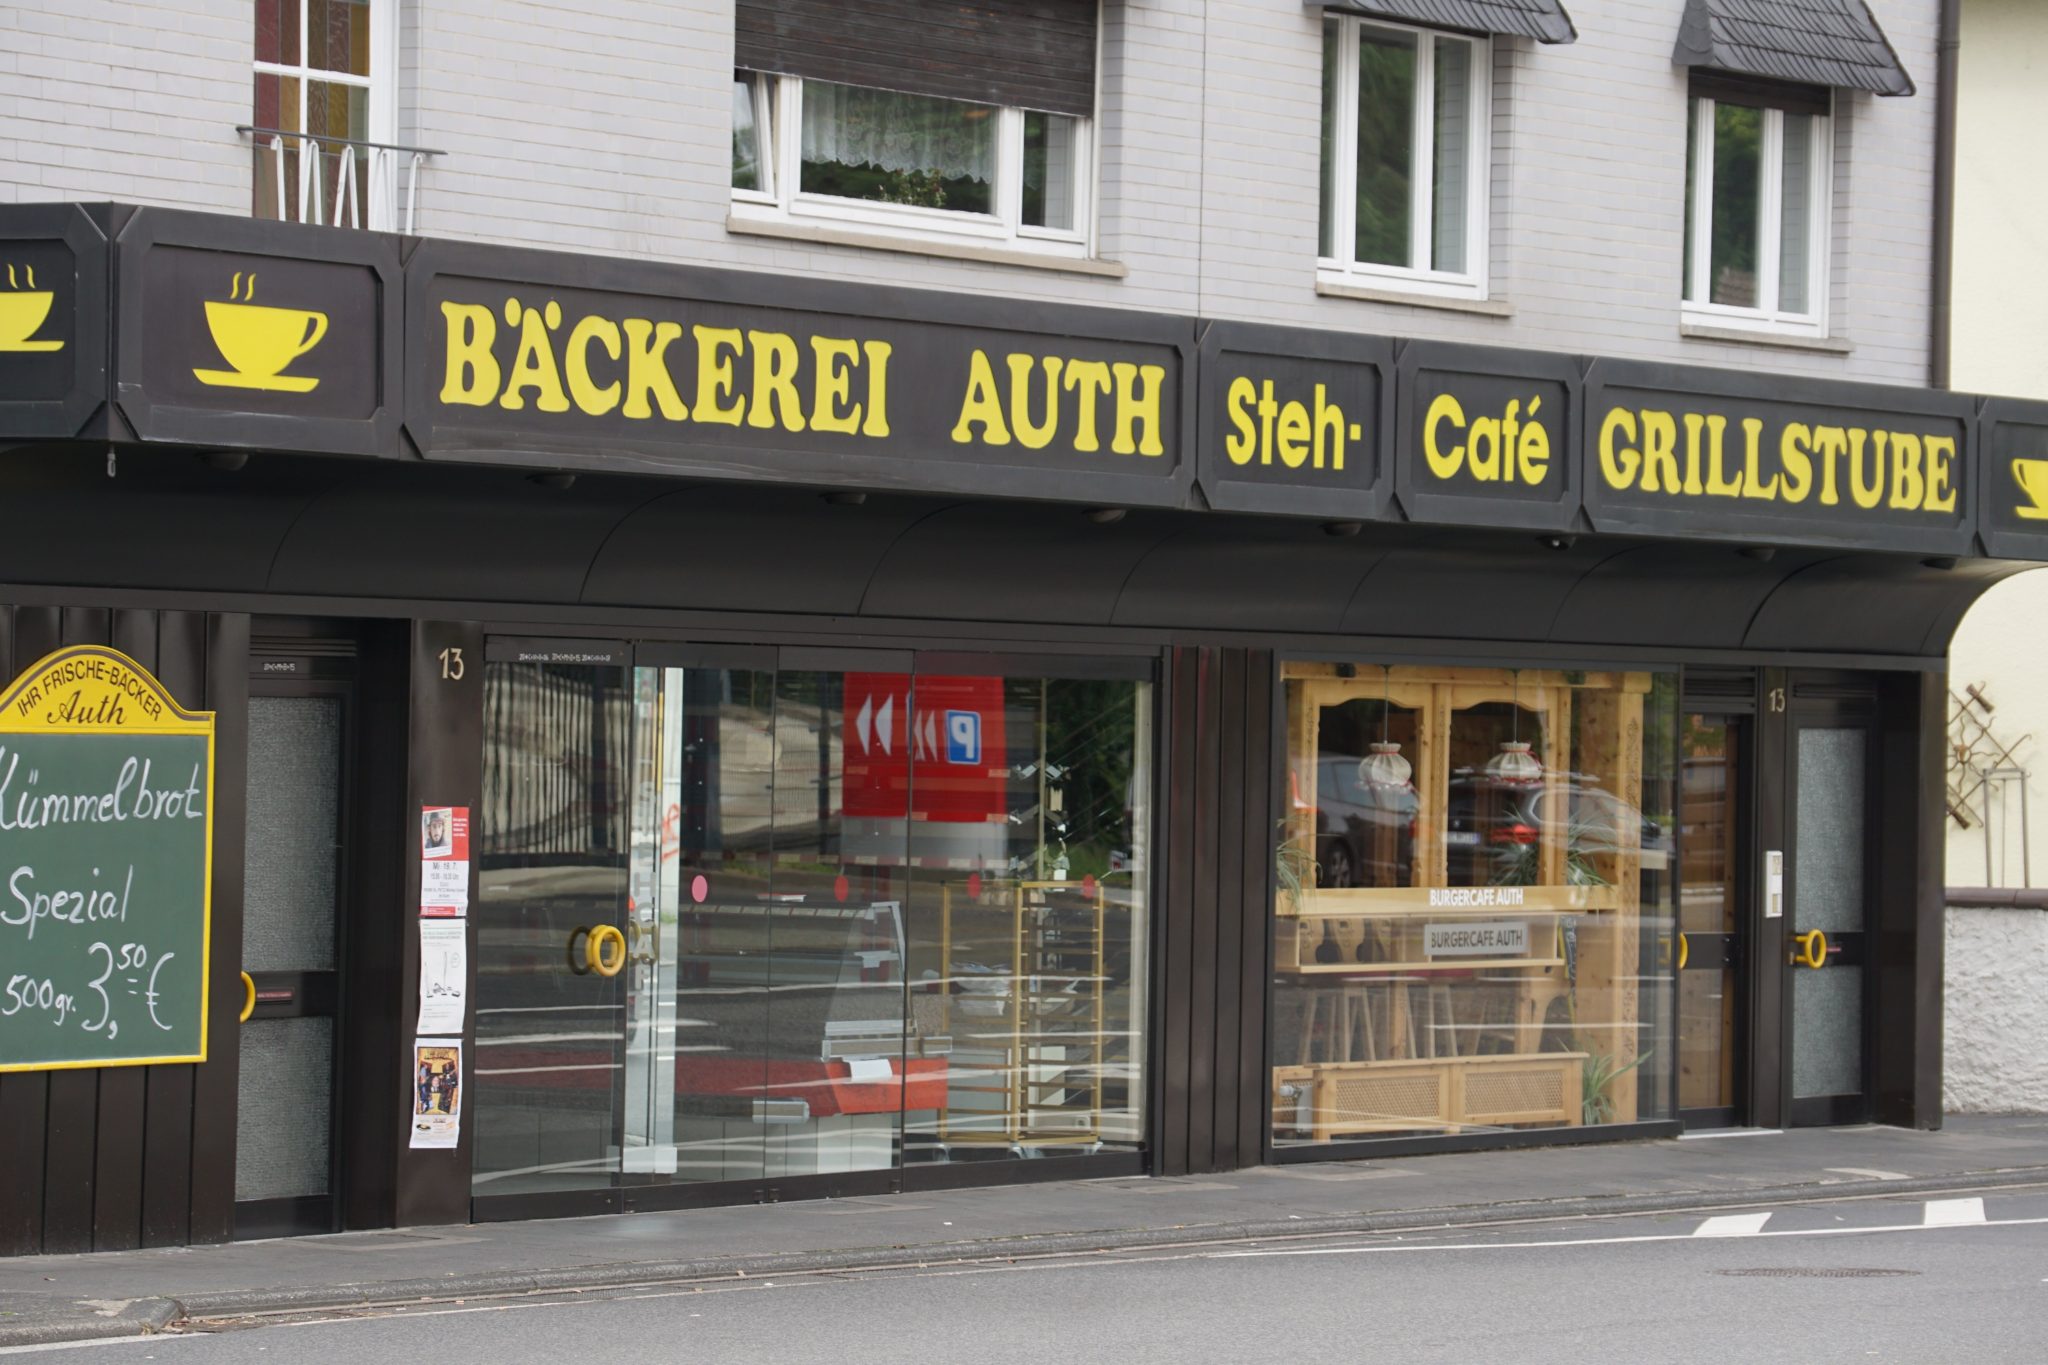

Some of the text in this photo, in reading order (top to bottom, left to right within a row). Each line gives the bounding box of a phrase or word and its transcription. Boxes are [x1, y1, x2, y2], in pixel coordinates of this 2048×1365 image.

[439, 297, 1166, 457] BÄCKEREI AUTH
[1226, 376, 1551, 486] Steh- Café
[1599, 406, 1958, 513] GRILLSTUBE
[439, 647, 465, 681] 13
[16, 659, 164, 722] IHR FRISCHE-BÄCKER
[46, 689, 128, 726] Auth
[1769, 687, 1786, 713] 13
[0, 864, 134, 941] Spezial
[1429, 887, 1524, 907] BURGERCAFE AUTH
[1431, 929, 1523, 949] BURGERCAFE AUTH
